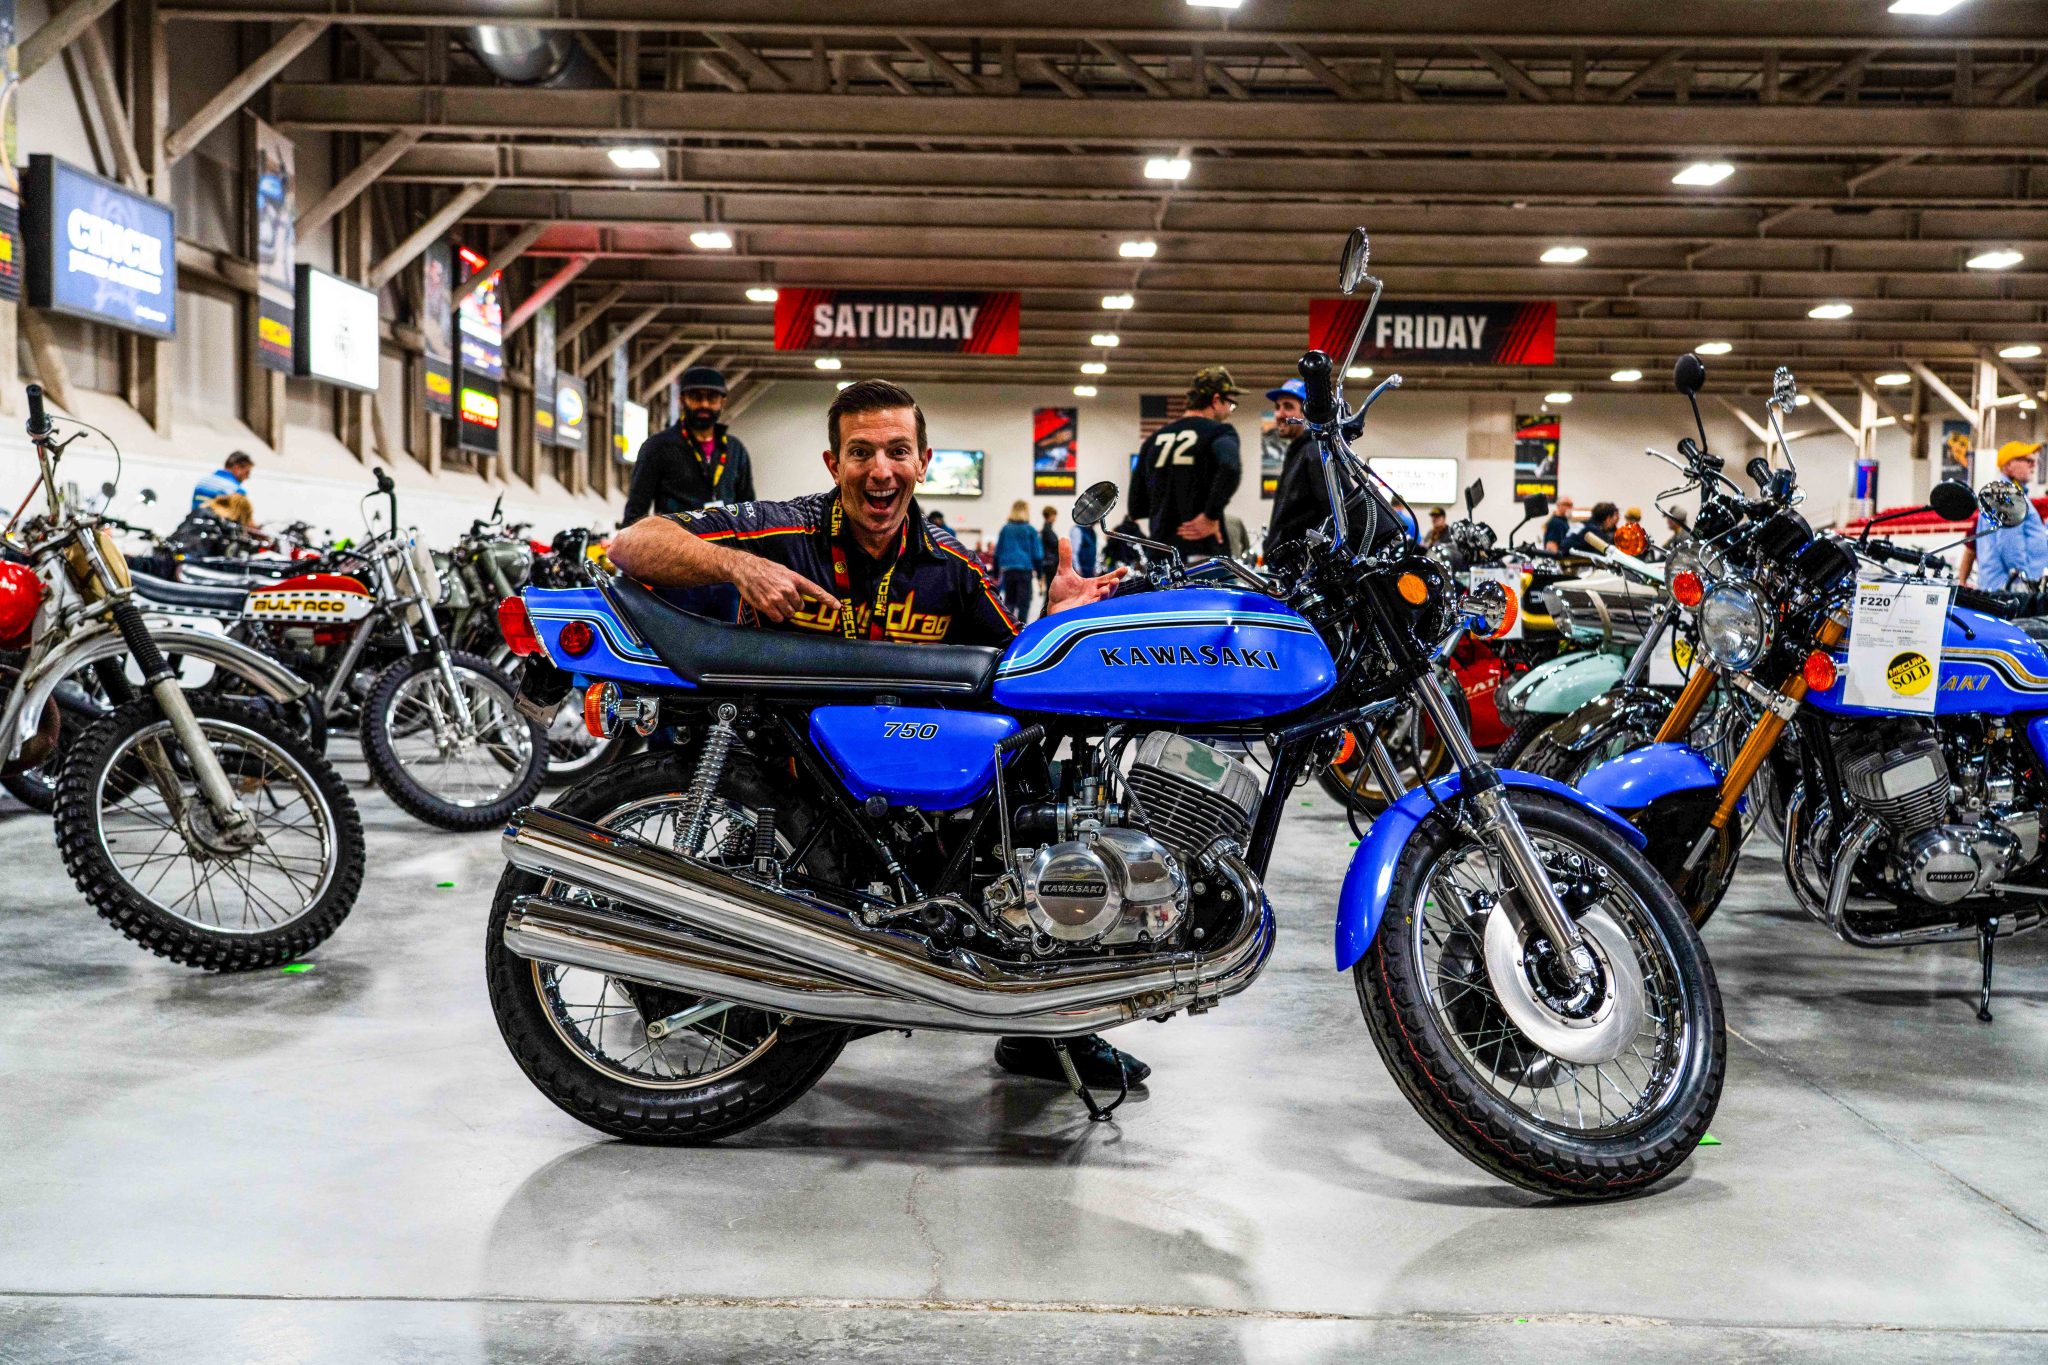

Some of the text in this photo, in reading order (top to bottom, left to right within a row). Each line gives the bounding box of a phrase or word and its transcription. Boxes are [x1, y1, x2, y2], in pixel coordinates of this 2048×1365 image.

[813, 303, 979, 340] SATURDAY
[1375, 314, 1488, 350] FRIDAY
[1154, 429, 1198, 468] 72
[831, 497, 843, 536] ECUM
[254, 600, 345, 613] BULTACO
[1860, 596, 1891, 607] F220
[840, 597, 857, 640] MECU
[1099, 645, 1280, 671] KAWASAKI
[1888, 655, 1926, 677] MECUM
[1891, 664, 1931, 690] SOLD
[883, 721, 939, 740] 750
[1042, 884, 1104, 894] KAWASAKI
[1929, 873, 1973, 881] KAWASAKI
